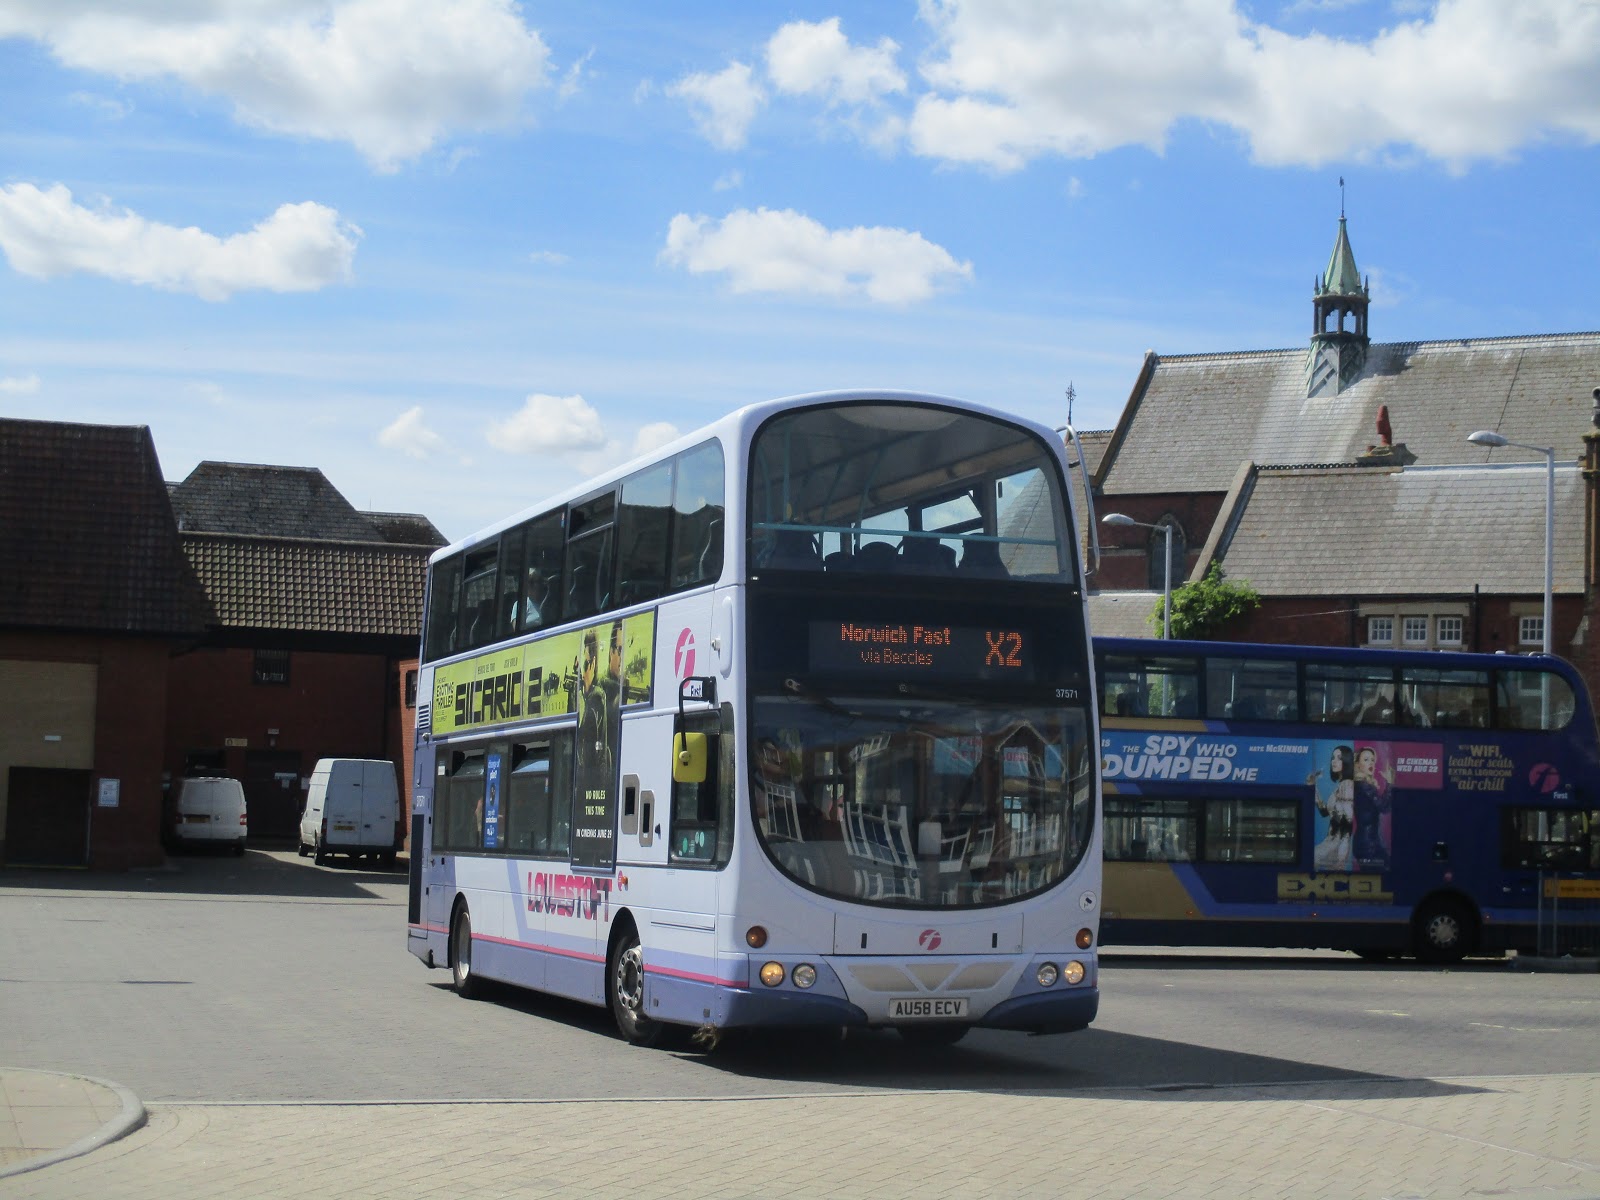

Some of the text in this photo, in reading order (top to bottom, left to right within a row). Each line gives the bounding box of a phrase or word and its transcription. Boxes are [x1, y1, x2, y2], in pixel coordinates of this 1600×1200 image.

[841, 623, 950, 645] Norwich Fast
[861, 647, 933, 665] via Beccles
[985, 631, 1022, 666] X2
[528, 666, 543, 715] 2
[1055, 688, 1078, 699] 37571
[1122, 735, 1237, 758] THE SPY WHO
[1102, 754, 1259, 781] DUMPED ME
[1397, 757, 1438, 766] IN CINEMAS
[1413, 765, 1428, 773] AUG
[1428, 765, 1439, 773] 22
[1448, 755, 1485, 768] leather
[1448, 768, 1473, 776] EXTRA
[1553, 791, 1568, 800] First
[585, 805, 594, 816] THIS
[1277, 872, 1394, 899] EXCEL
[527, 872, 613, 922] LOWESTOFT
[896, 1001, 961, 1015] AU58 ECV
